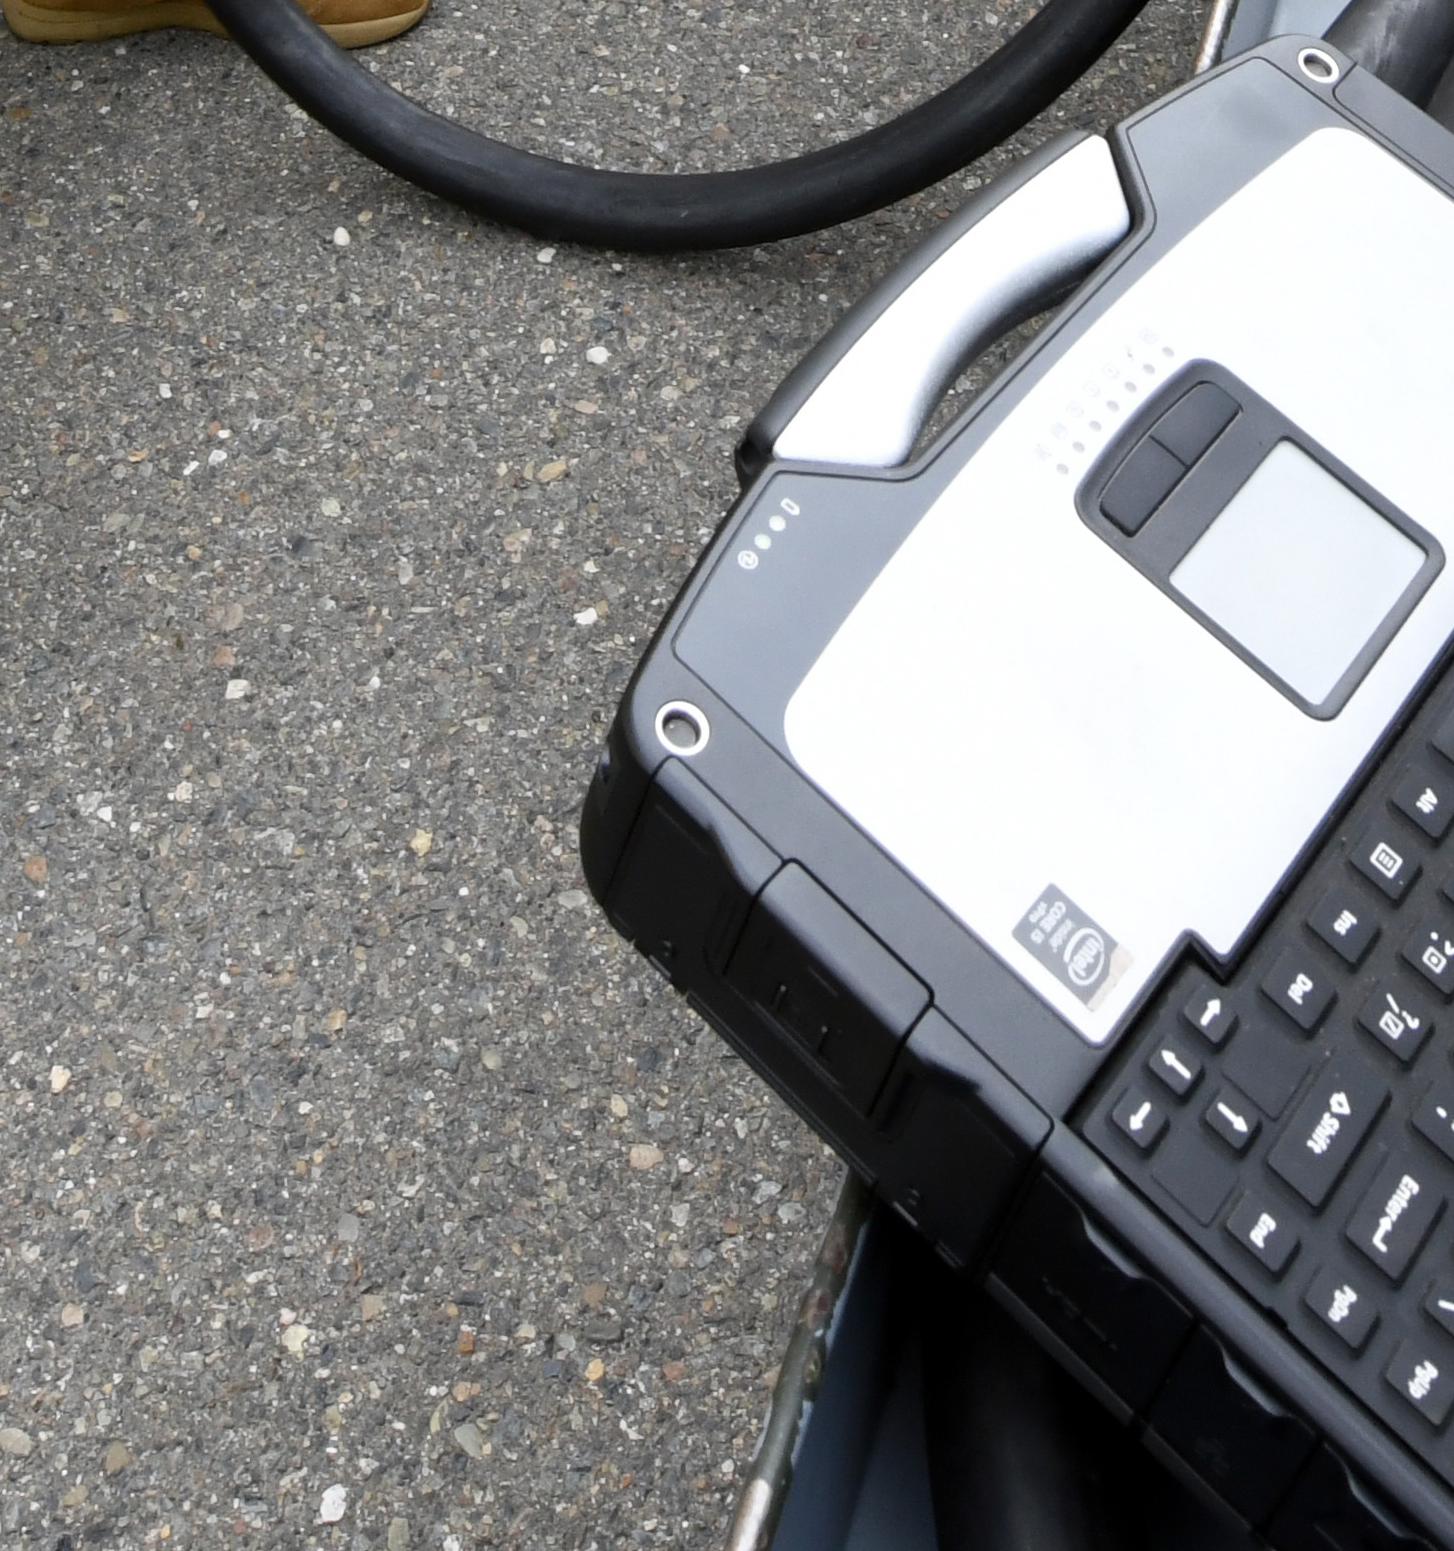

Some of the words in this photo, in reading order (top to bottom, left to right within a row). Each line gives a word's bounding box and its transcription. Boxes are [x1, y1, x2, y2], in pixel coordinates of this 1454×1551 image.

[1416, 788, 1438, 813] Alt
[1040, 901, 1066, 934] CORE
[1334, 910, 1357, 935] Ins
[1071, 936, 1104, 978] intel
[1288, 973, 1313, 1005] Del
[1307, 1112, 1339, 1154] Shift
[1384, 1175, 1419, 1221] Enter
[1250, 1213, 1276, 1248] End
[1328, 1285, 1357, 1322] PgDn
[1408, 1360, 1438, 1399] PgUp
